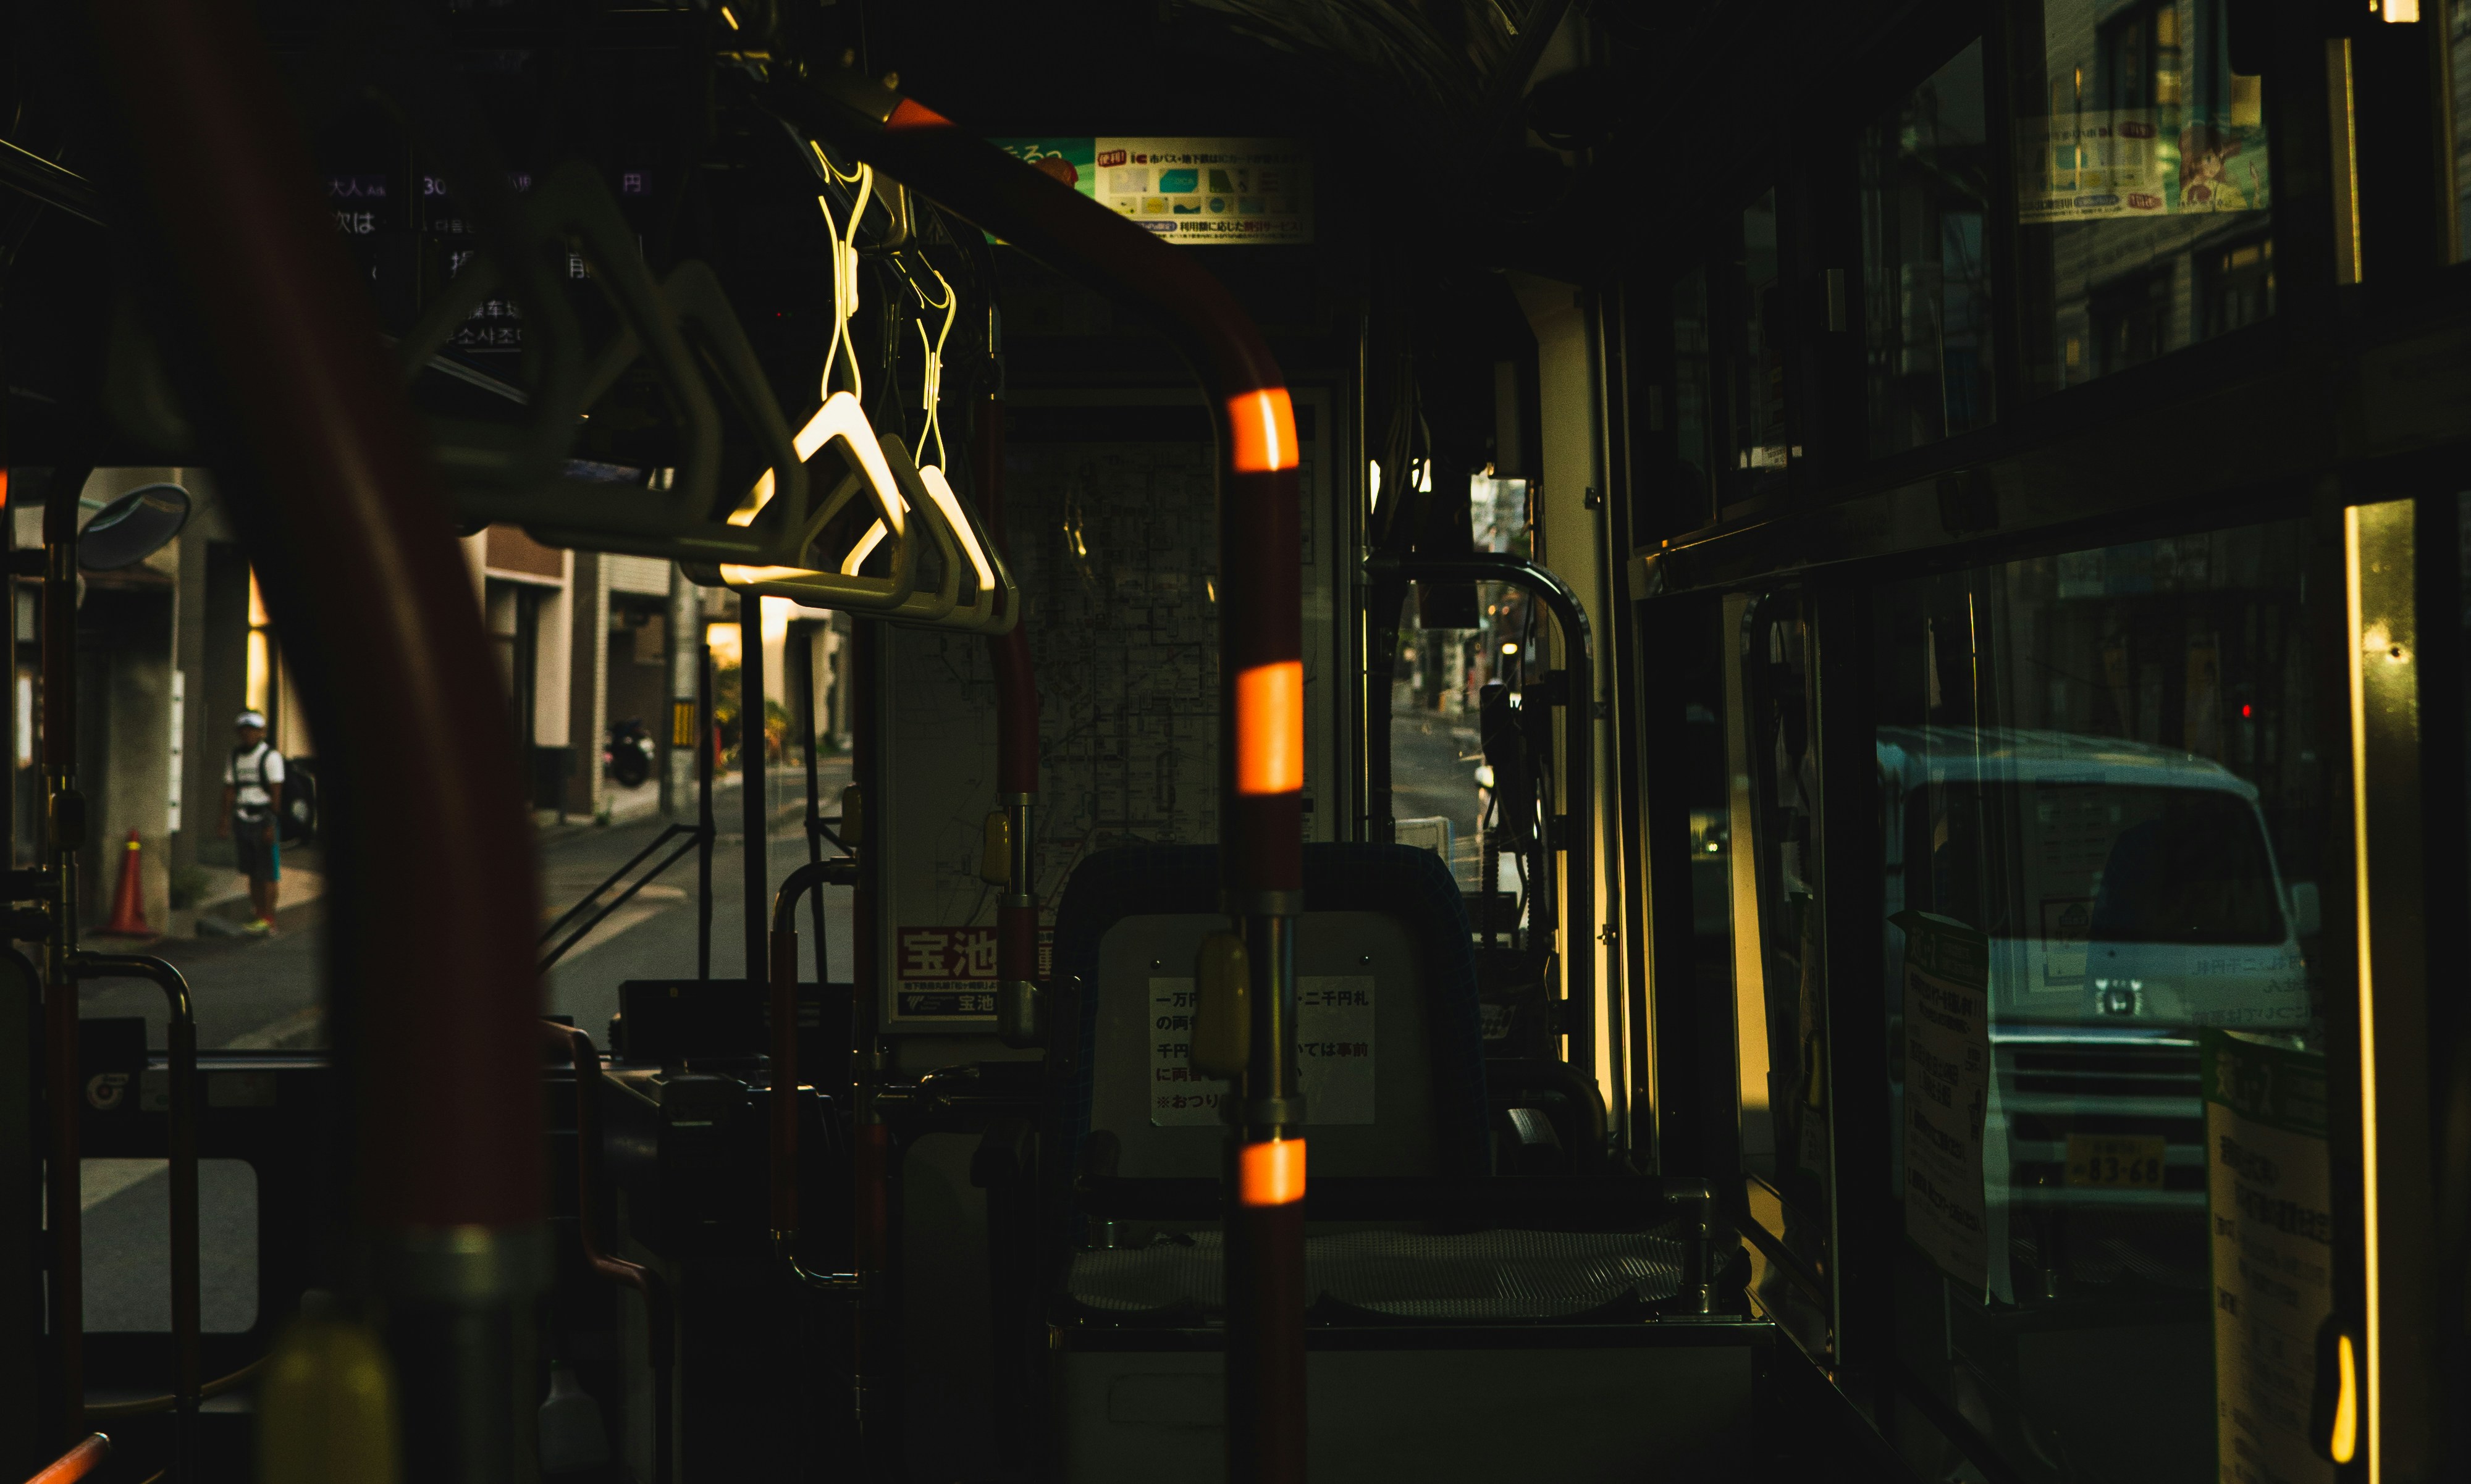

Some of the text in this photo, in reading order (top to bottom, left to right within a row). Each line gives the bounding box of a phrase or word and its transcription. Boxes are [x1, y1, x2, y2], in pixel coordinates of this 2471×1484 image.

[329, 177, 363, 197] 大人
[623, 172, 641, 193] 円
[958, 995, 994, 1011] 宝池
